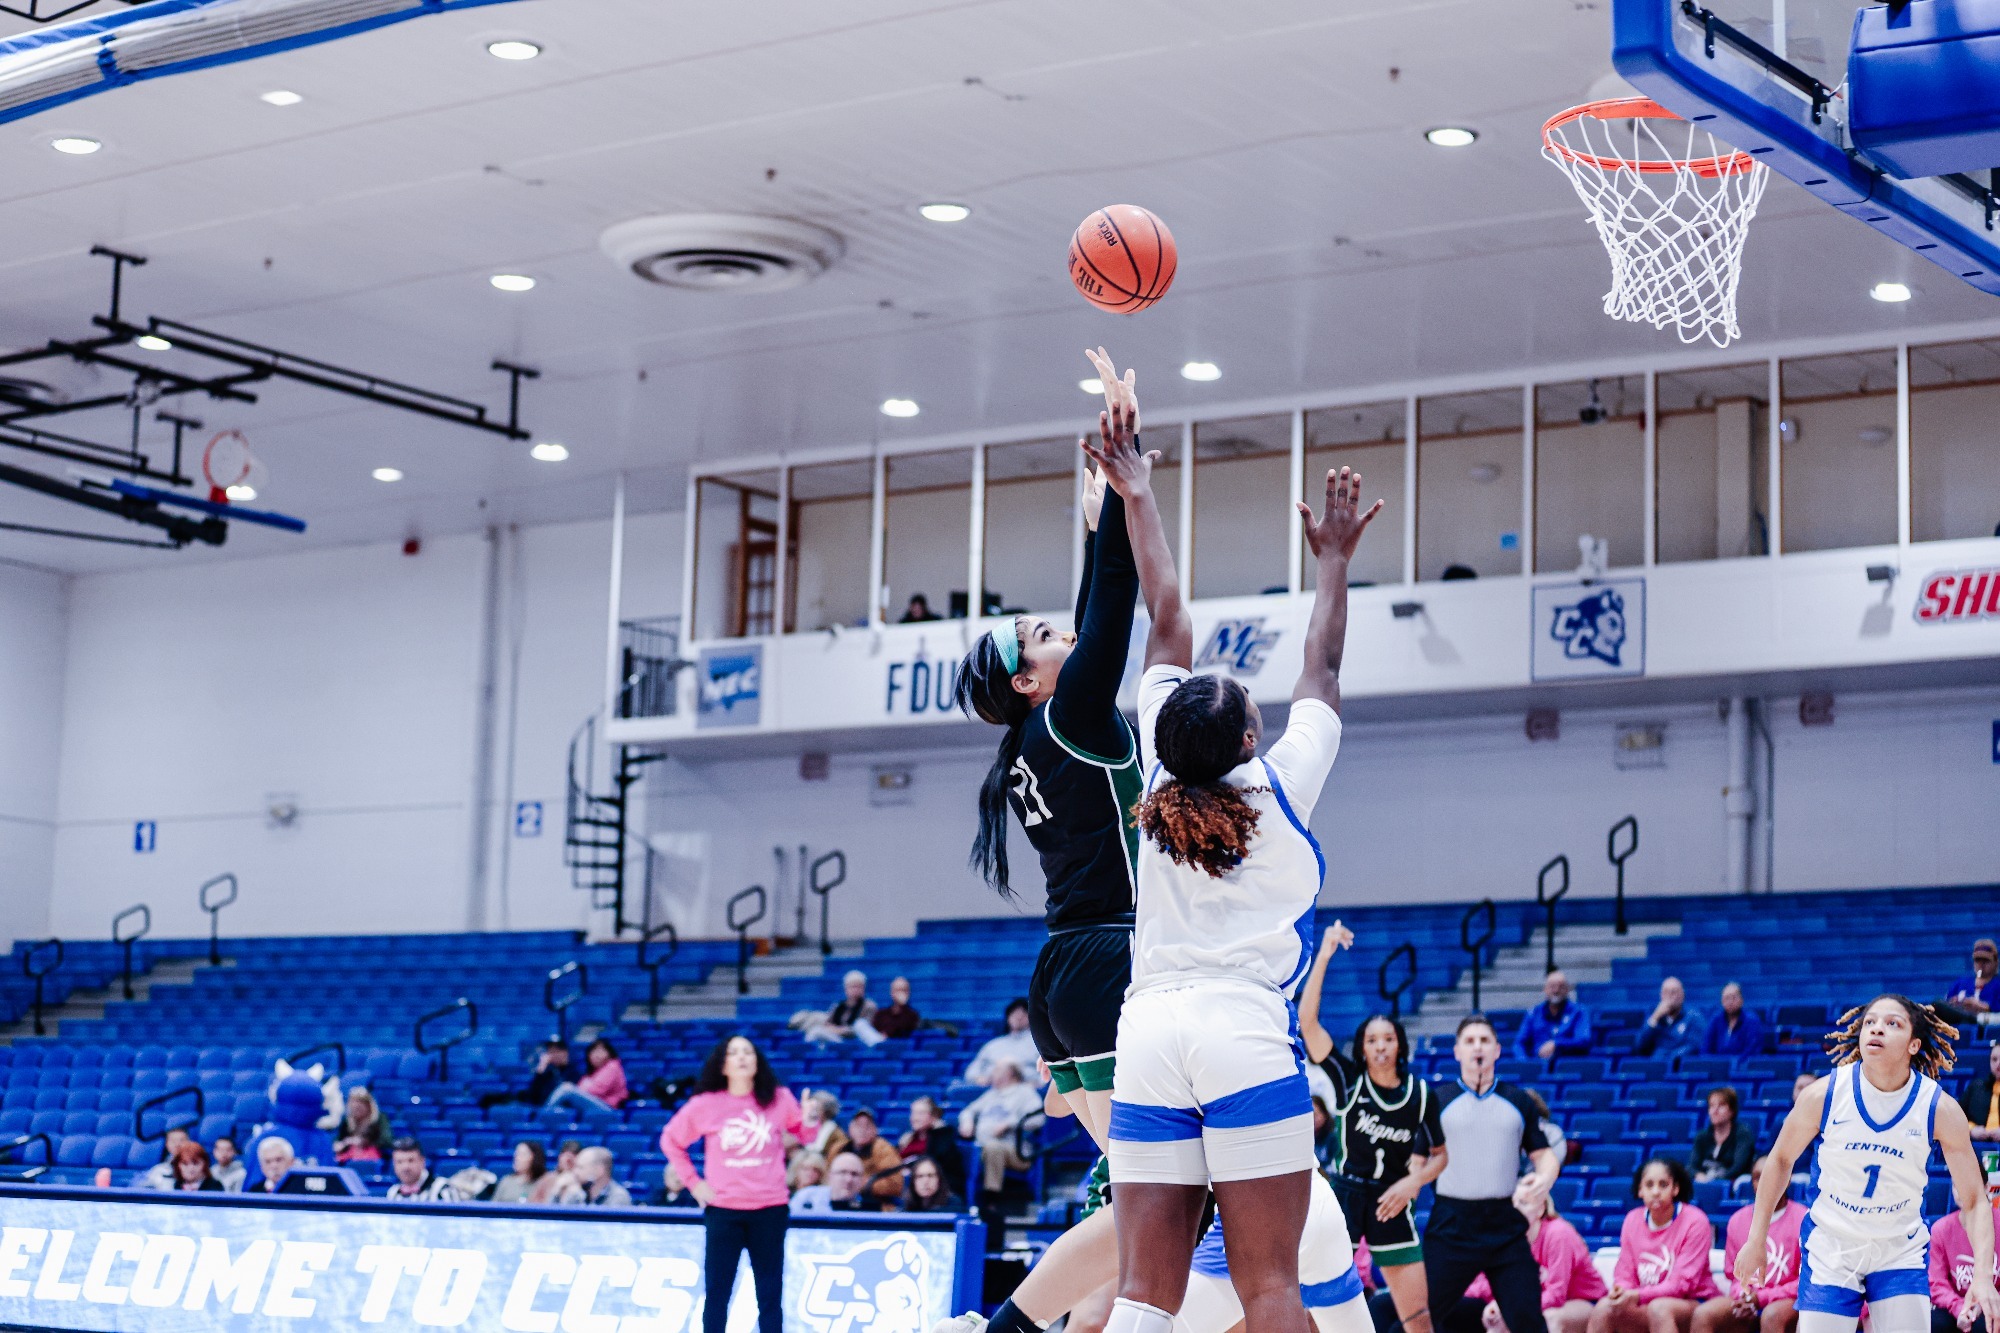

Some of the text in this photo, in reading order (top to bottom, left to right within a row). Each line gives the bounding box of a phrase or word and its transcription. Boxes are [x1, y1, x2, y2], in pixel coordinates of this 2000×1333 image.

[1076, 266, 1104, 297] THE
[886, 660, 957, 714] FDU
[1009, 755, 1054, 827] 21
[1355, 1109, 1412, 1144] Wagner
[1373, 1148, 1385, 1179] 1
[1844, 1142, 1905, 1159] CENTRAL
[1862, 1164, 1882, 1199] 1
[355, 1244, 488, 1327] TO
